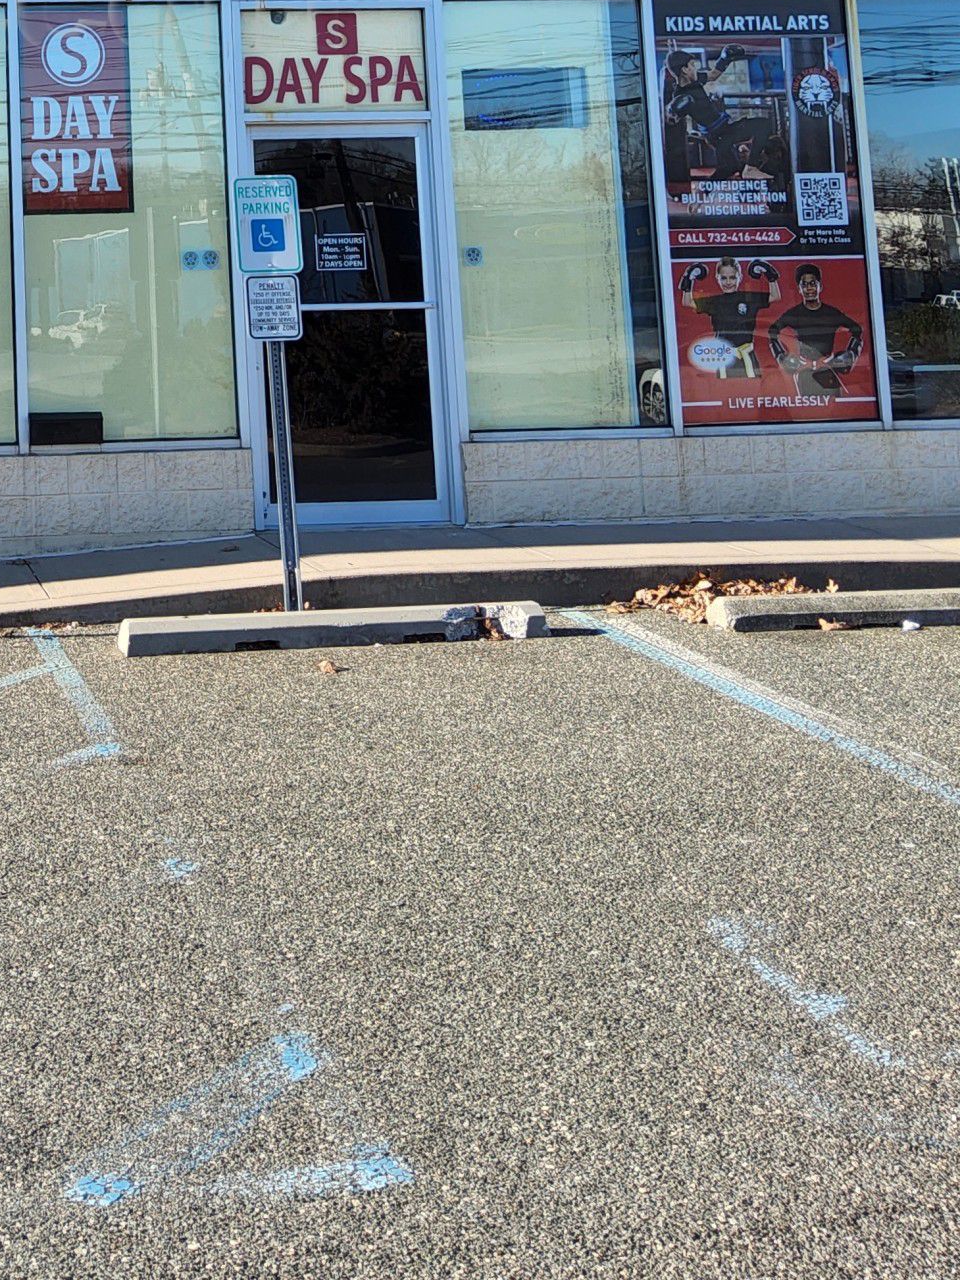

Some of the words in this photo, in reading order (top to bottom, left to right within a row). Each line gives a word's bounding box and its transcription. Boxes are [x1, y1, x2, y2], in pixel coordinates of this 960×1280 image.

[665, 16, 706, 32] KIDS
[709, 15, 783, 32] MARTIAL
[786, 14, 830, 31] ARTS
[325, 19, 348, 49] S
[61, 31, 87, 78] S
[244, 56, 330, 104] DAY
[343, 55, 424, 104] SPA
[31, 96, 119, 140] DAY
[31, 147, 122, 193] SPA
[237, 184, 293, 199] RESERVED
[698, 180, 769, 192] CONFIDENCE
[681, 193, 715, 204] BULLY
[718, 191, 787, 203] PREVENTION
[242, 201, 290, 215] PARKING
[704, 204, 766, 216] DISCIPLINE
[678, 233, 706, 244] CALL
[707, 231, 781, 243] 732-416-4426
[816, 228, 832, 236] More
[338, 237, 362, 245] HOURS
[258, 282, 285, 290] PENALTY
[693, 344, 732, 357] Google
[728, 396, 755, 409] LIVE
[757, 394, 831, 408] FEARLESSLY
